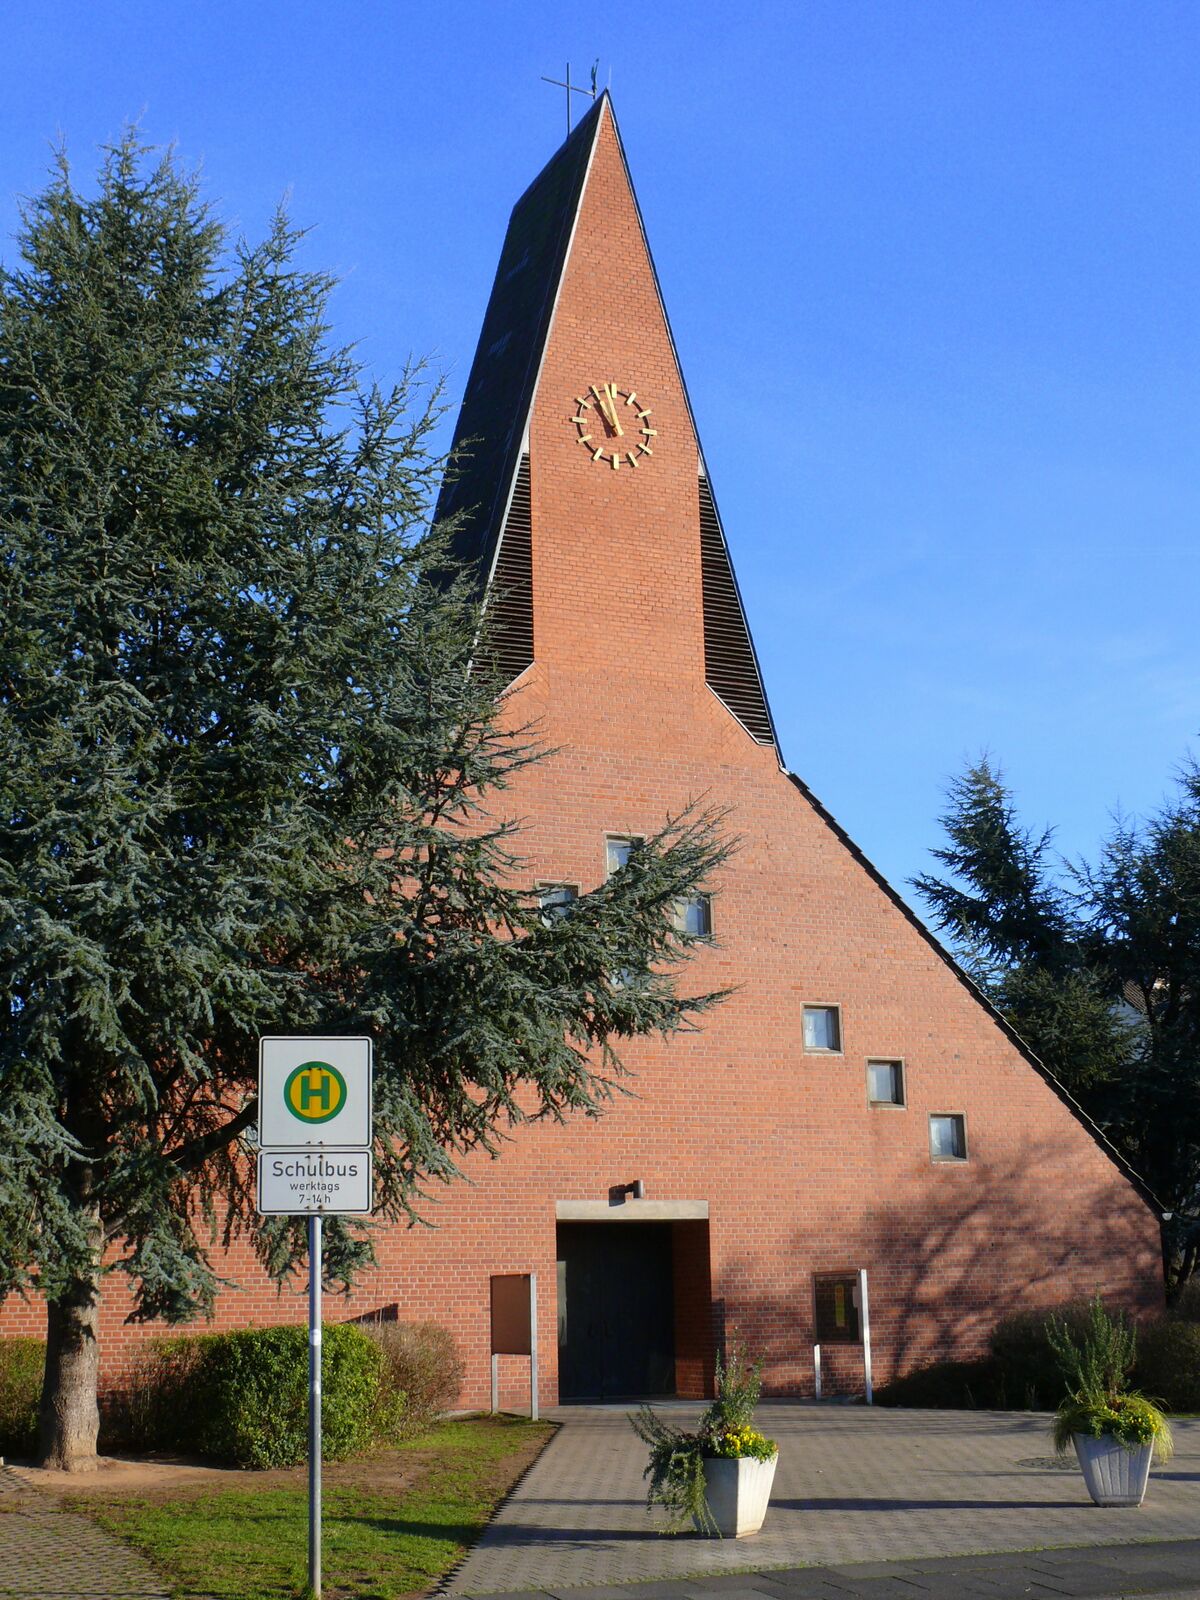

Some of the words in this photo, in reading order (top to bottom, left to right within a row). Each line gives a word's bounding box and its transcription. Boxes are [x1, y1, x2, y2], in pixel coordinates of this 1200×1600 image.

[300, 1075, 330, 1110] H
[272, 1161, 358, 1177] Schulbus
[289, 1181, 340, 1193] werktags
